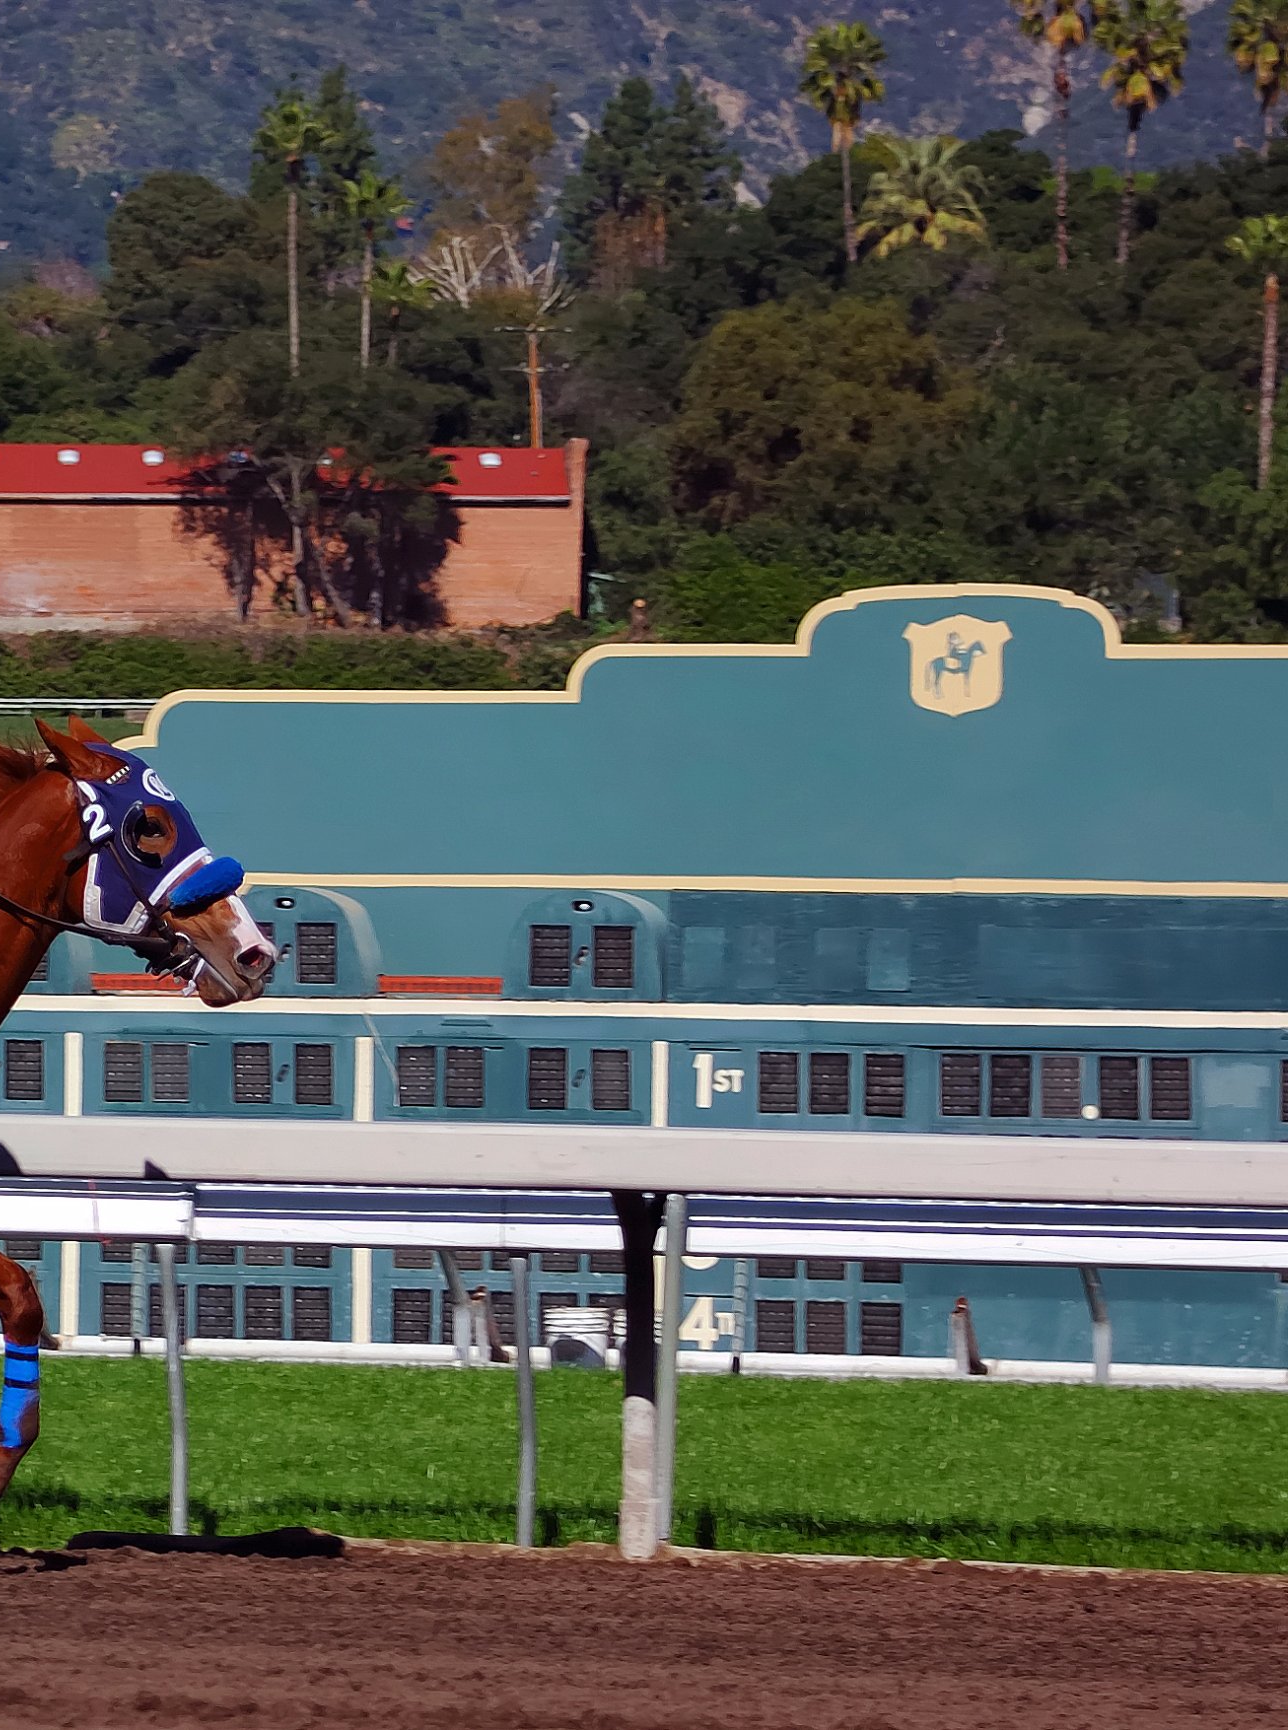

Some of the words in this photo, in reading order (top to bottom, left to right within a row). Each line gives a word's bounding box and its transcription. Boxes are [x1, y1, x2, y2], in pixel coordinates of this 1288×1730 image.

[82, 804, 113, 842] 2
[692, 1053, 745, 1108] 1ST
[678, 1296, 736, 1350] 4T
